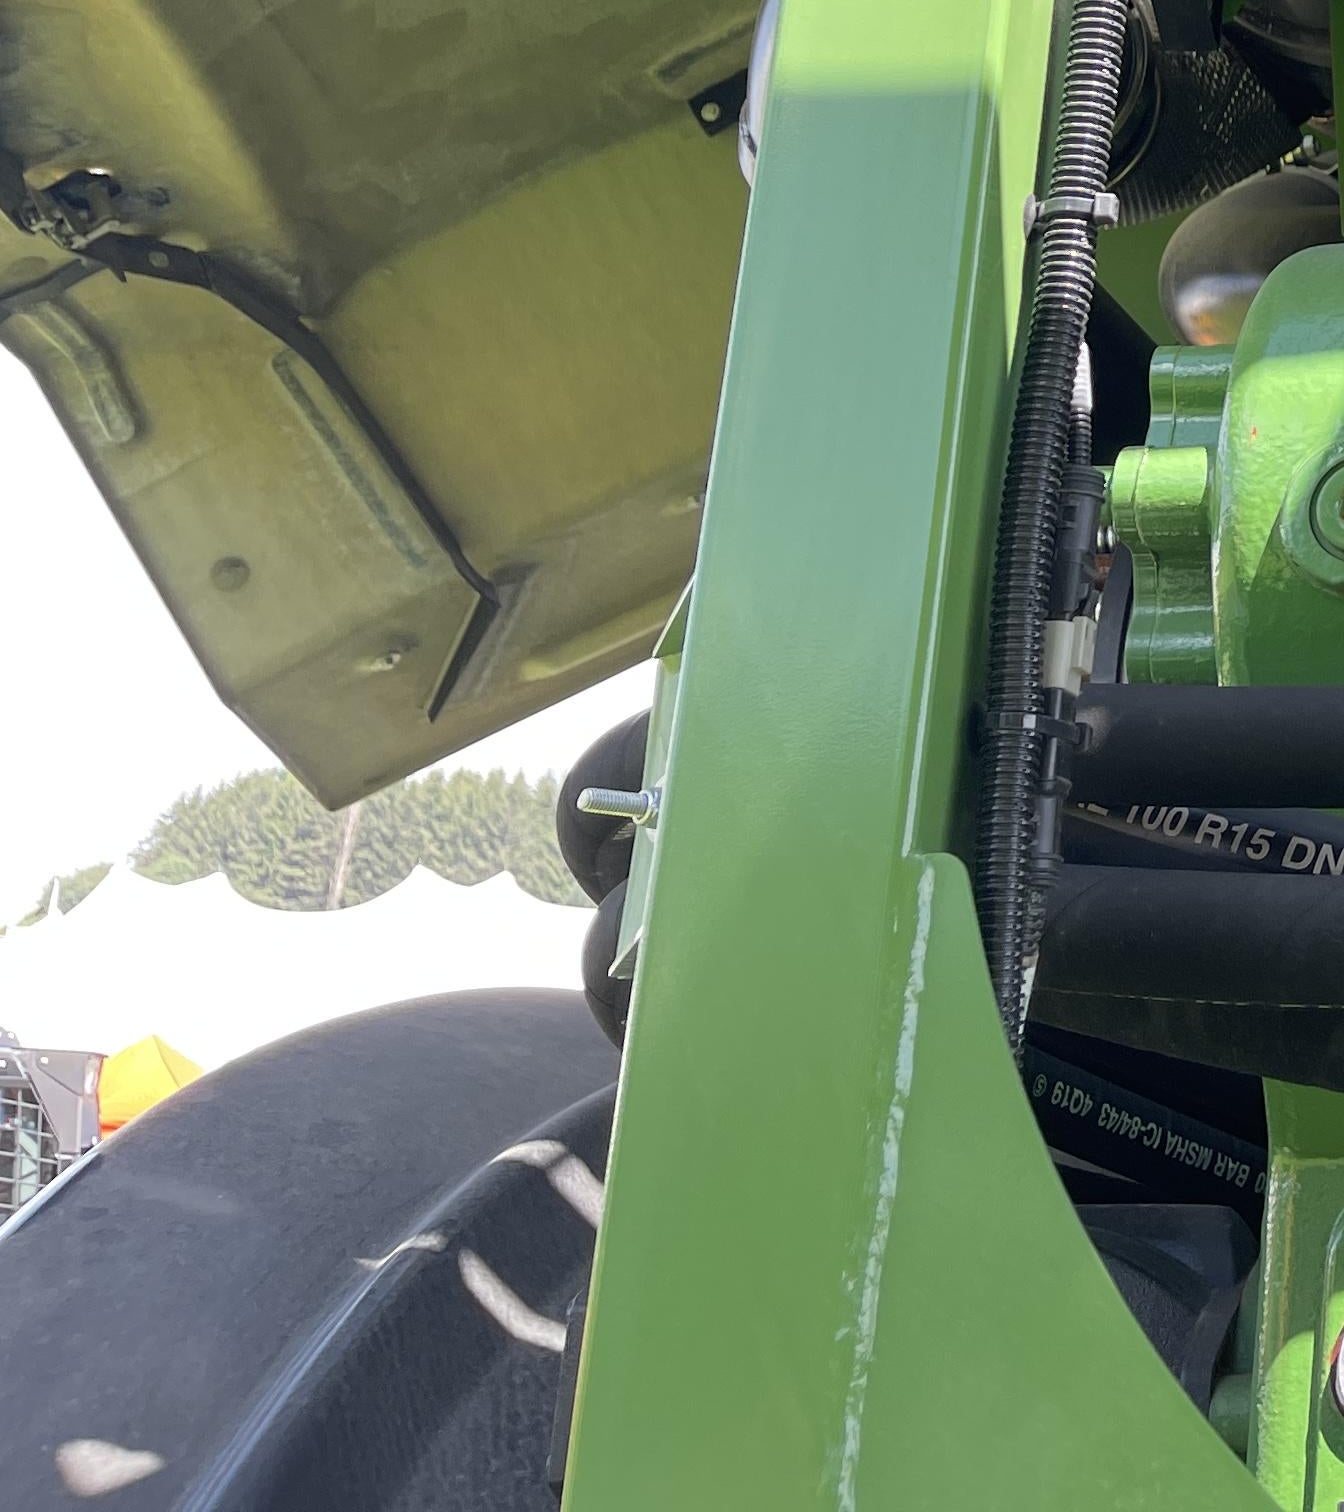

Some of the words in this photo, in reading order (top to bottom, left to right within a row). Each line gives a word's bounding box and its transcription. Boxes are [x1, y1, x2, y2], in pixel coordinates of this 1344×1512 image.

[1194, 813, 1276, 861] R15
[1051, 1080, 1094, 1117] 4Q19
[1098, 1103, 1163, 1150] IC-84/43
[1164, 1130, 1214, 1171] MSHA
[1214, 1152, 1251, 1188] BAR
